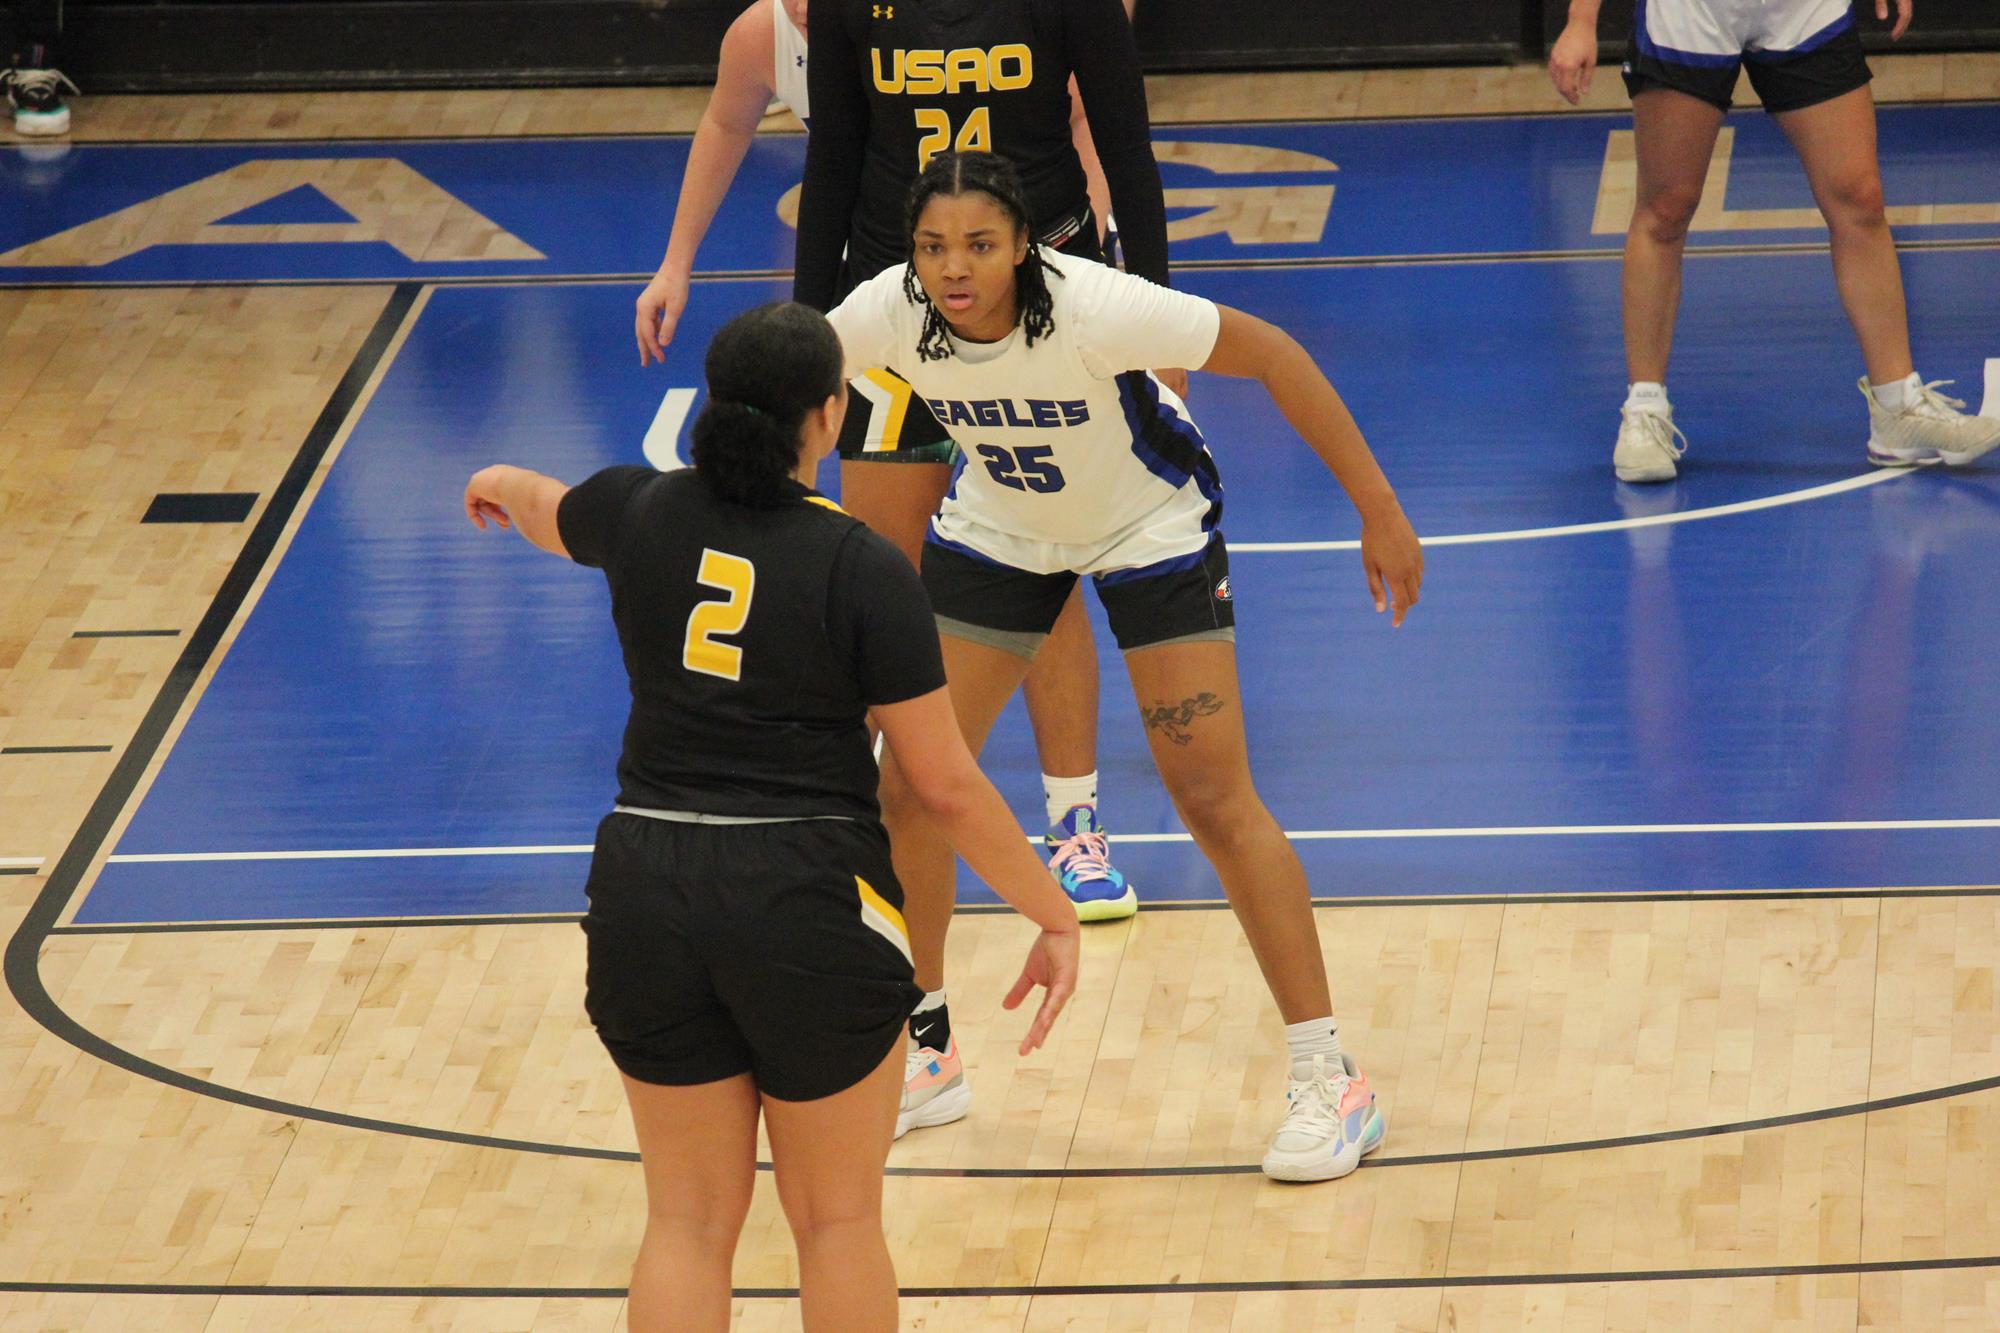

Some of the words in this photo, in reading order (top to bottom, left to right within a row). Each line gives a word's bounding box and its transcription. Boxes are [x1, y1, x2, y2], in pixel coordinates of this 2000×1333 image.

[871, 43, 1033, 95] USAO
[914, 106, 992, 175] 24
[925, 398, 1091, 428] EAGLES
[975, 443, 1066, 494] 25
[682, 547, 756, 682] 2
